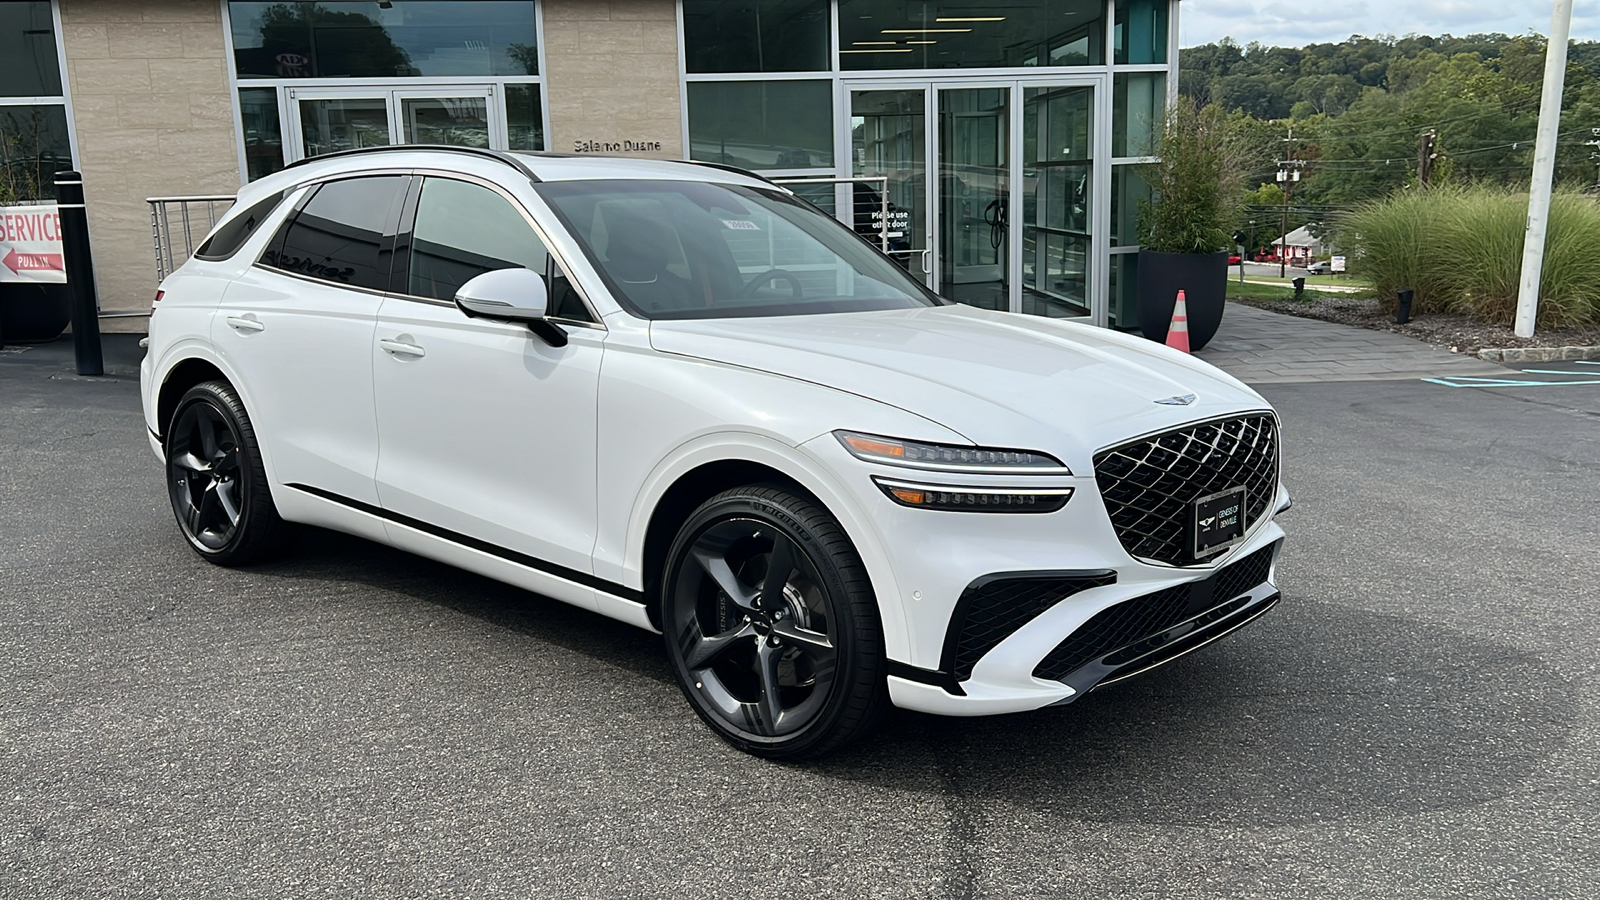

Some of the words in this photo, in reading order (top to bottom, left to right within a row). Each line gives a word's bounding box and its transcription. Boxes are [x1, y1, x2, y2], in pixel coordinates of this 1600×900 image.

[624, 140, 661, 151] Duane
[871, 211, 895, 219] Plese
[0, 213, 62, 242] SERVICE
[891, 220, 907, 228] door
[18, 256, 39, 268] PULL
[764, 505, 812, 541] MICHELIN
